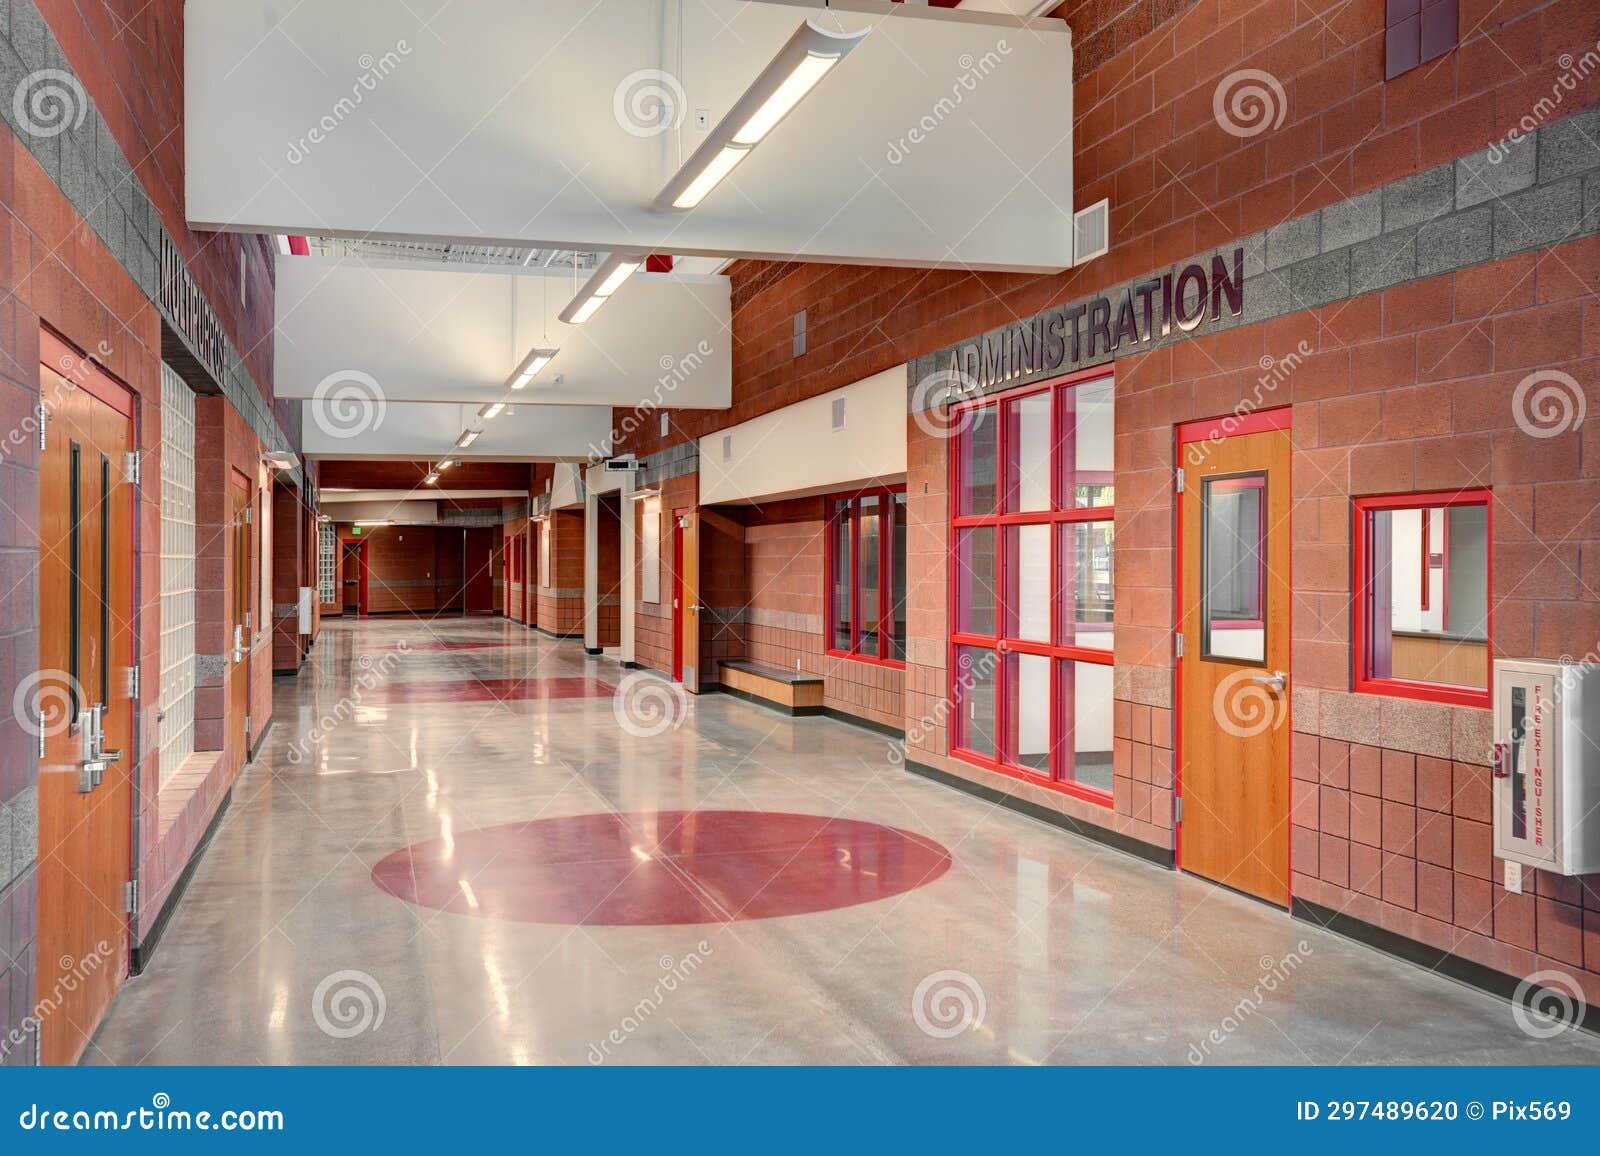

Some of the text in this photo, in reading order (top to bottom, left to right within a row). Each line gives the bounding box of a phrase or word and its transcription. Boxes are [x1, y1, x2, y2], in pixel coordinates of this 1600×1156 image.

[159, 228, 227, 388] MULTIPURPOSE
[946, 248, 1244, 398] ADMINISTRATION
[1534, 685, 1543, 846] FIRE EXTINGUISHER
